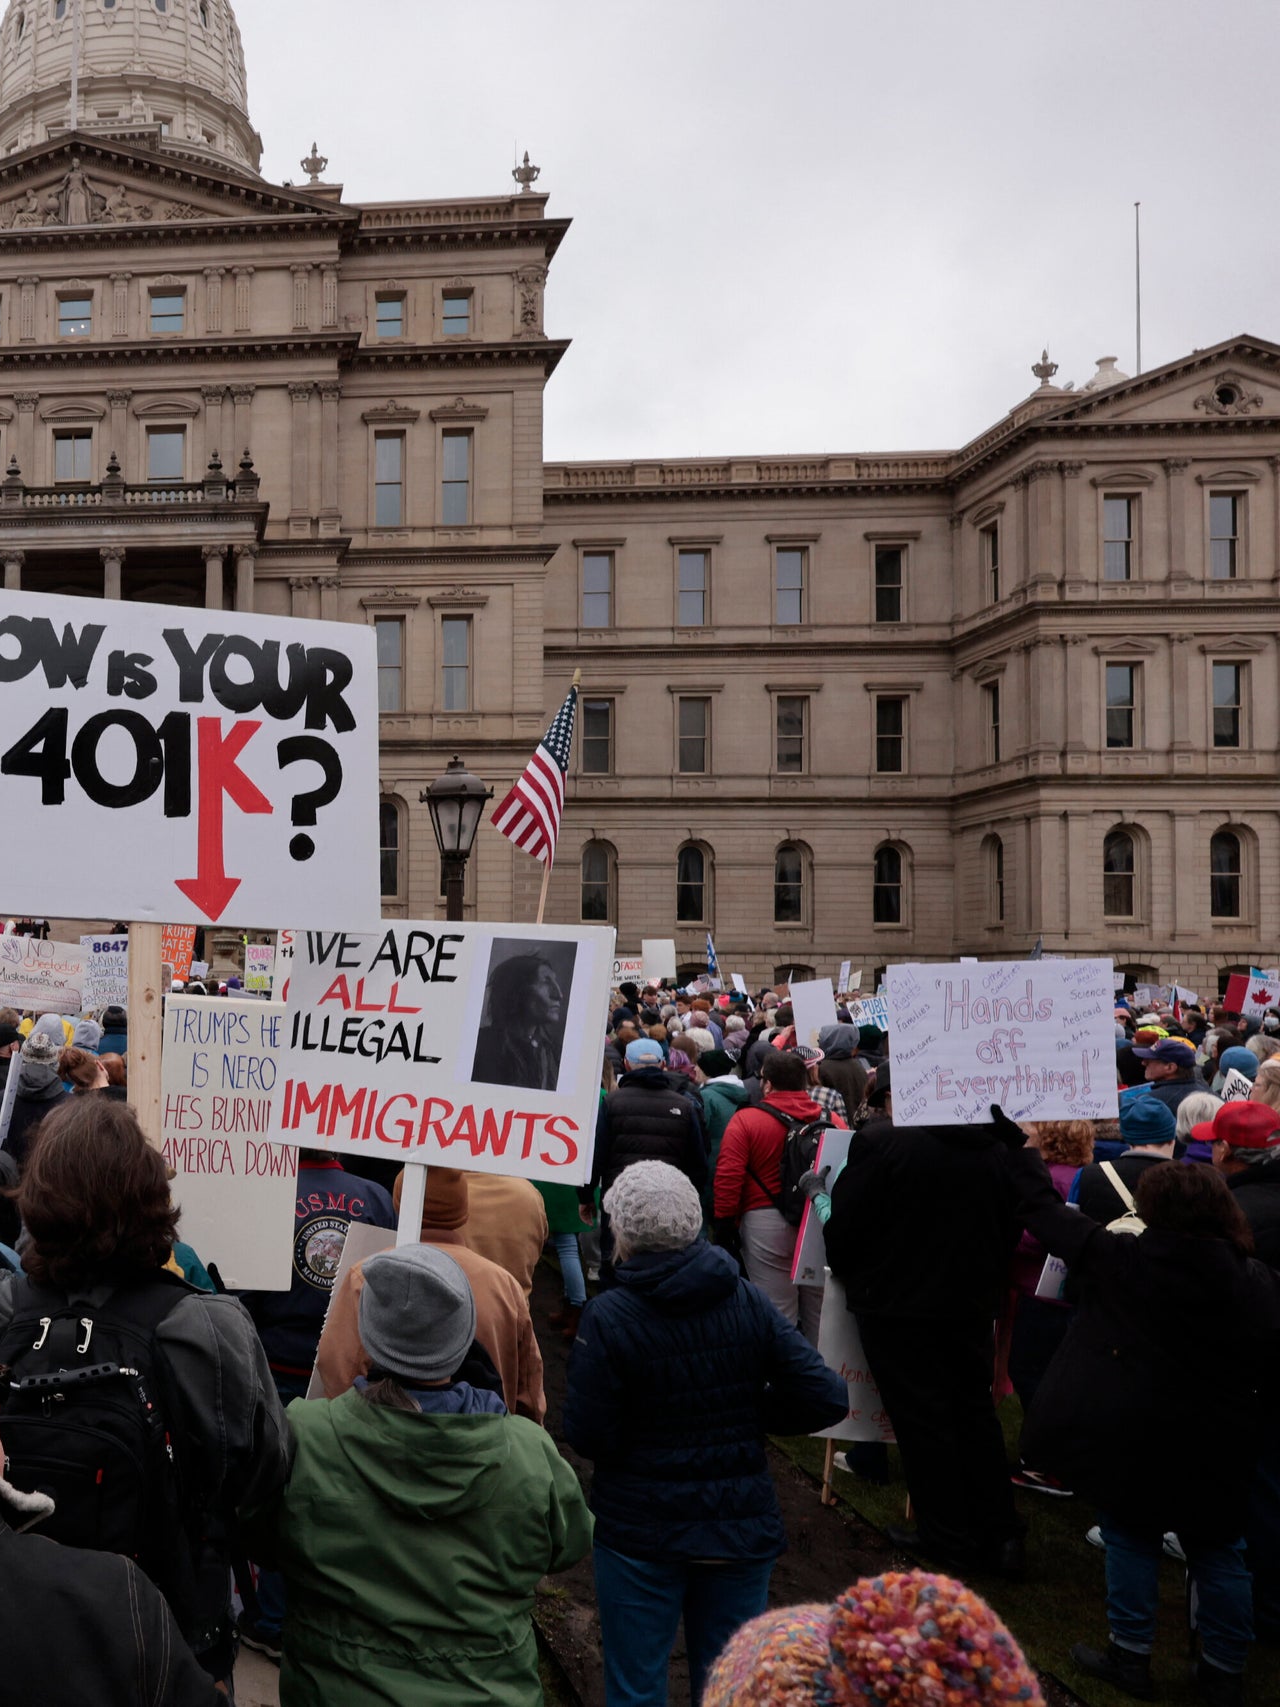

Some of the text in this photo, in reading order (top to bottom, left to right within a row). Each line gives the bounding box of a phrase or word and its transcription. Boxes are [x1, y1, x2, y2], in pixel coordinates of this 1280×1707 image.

[162, 627, 357, 734] YOUR
[27, 939, 55, 958] NO
[93, 940, 129, 953] 8647
[367, 928, 466, 983] ARE
[317, 973, 423, 1015] ALL
[861, 996, 888, 1016] PUBLI
[1069, 986, 1108, 1001] Science
[895, 1002, 931, 1033] Families
[1061, 1001, 1103, 1029] Medicaid
[290, 1010, 443, 1065] ILLEGAL
[975, 1026, 1026, 1065] off
[191, 1052, 277, 1091] IS NERO
[898, 1064, 942, 1101] Education
[281, 1078, 581, 1167] IMMIGRANTS
[898, 1096, 928, 1123] LGBTQ
[162, 1136, 297, 1178] AMERICA DOWN
[294, 1191, 365, 1218] USMC
[301, 1220, 329, 1241] UNITED
